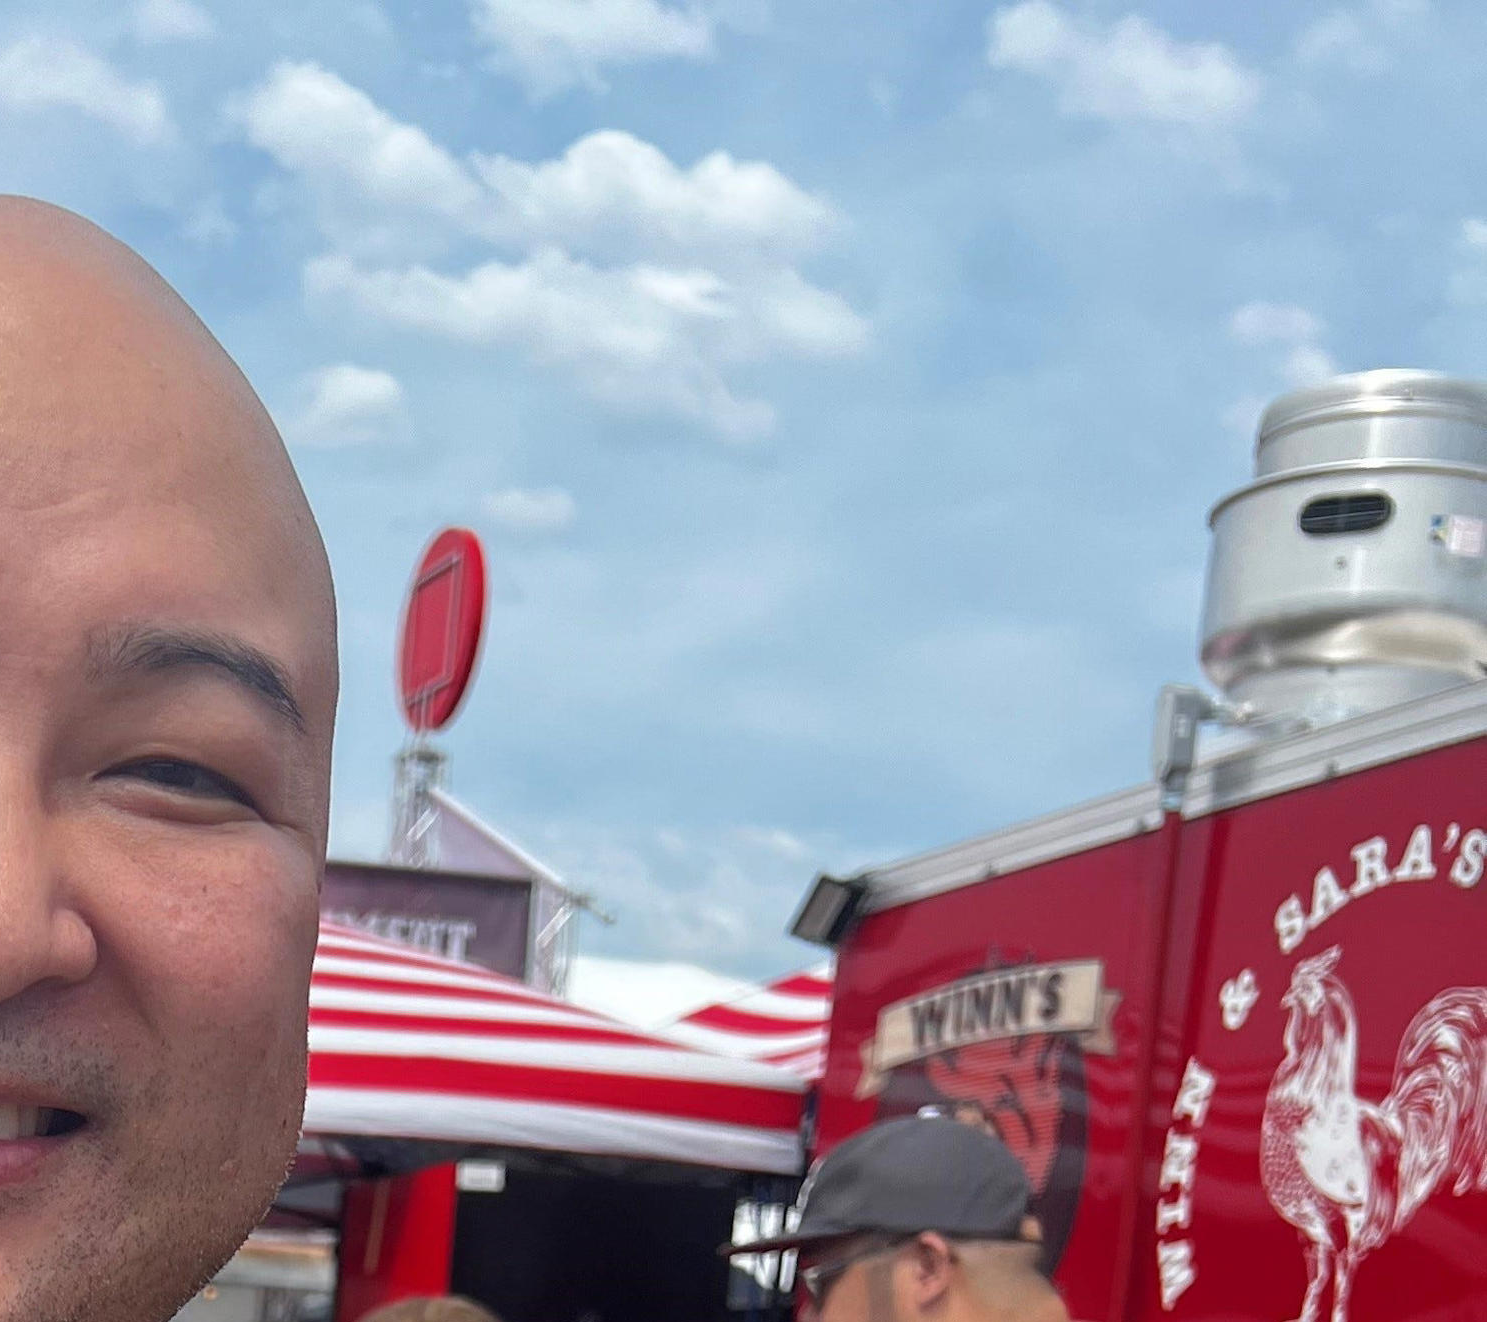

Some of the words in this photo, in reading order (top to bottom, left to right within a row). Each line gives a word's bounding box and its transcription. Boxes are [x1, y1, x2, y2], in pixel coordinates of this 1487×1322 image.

[1156, 1055, 1217, 1311] WINN
[1219, 967, 1260, 1031] &
[1273, 821, 1487, 955] SARA'S
